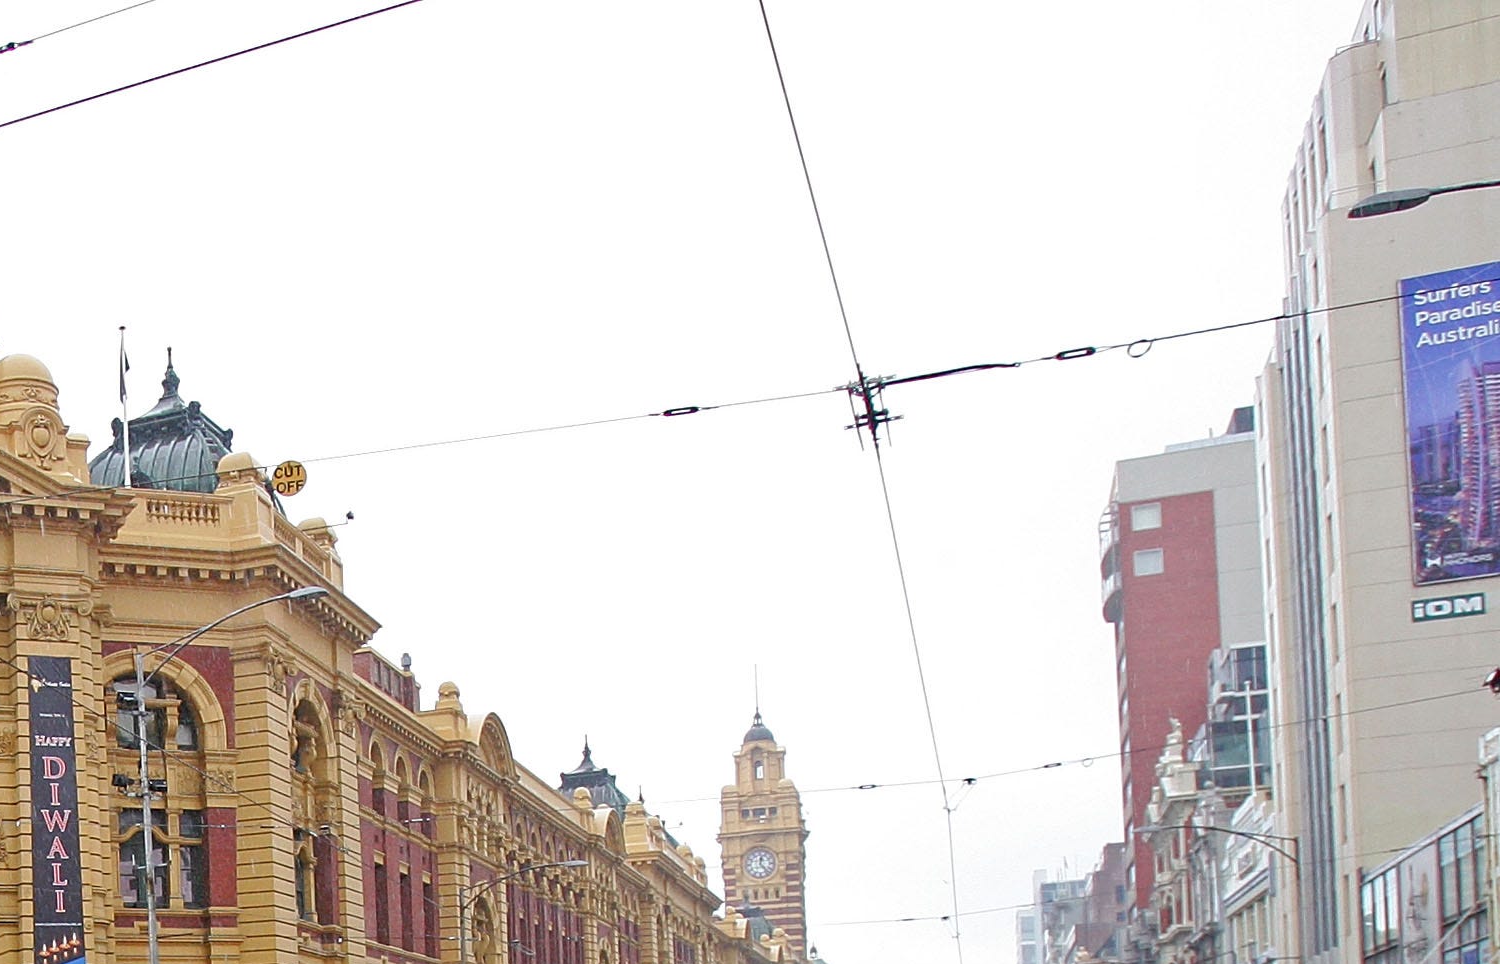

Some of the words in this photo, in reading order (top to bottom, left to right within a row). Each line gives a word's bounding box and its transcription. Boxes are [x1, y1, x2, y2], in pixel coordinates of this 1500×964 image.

[1413, 281, 1492, 306] Surfers
[1414, 300, 1500, 327] Paradise
[274, 464, 302, 479] CUT
[276, 480, 304, 494] OFF
[1413, 596, 1483, 618] iOM
[34, 735, 72, 747] HAPPY
[41, 756, 72, 914] DIWALI
